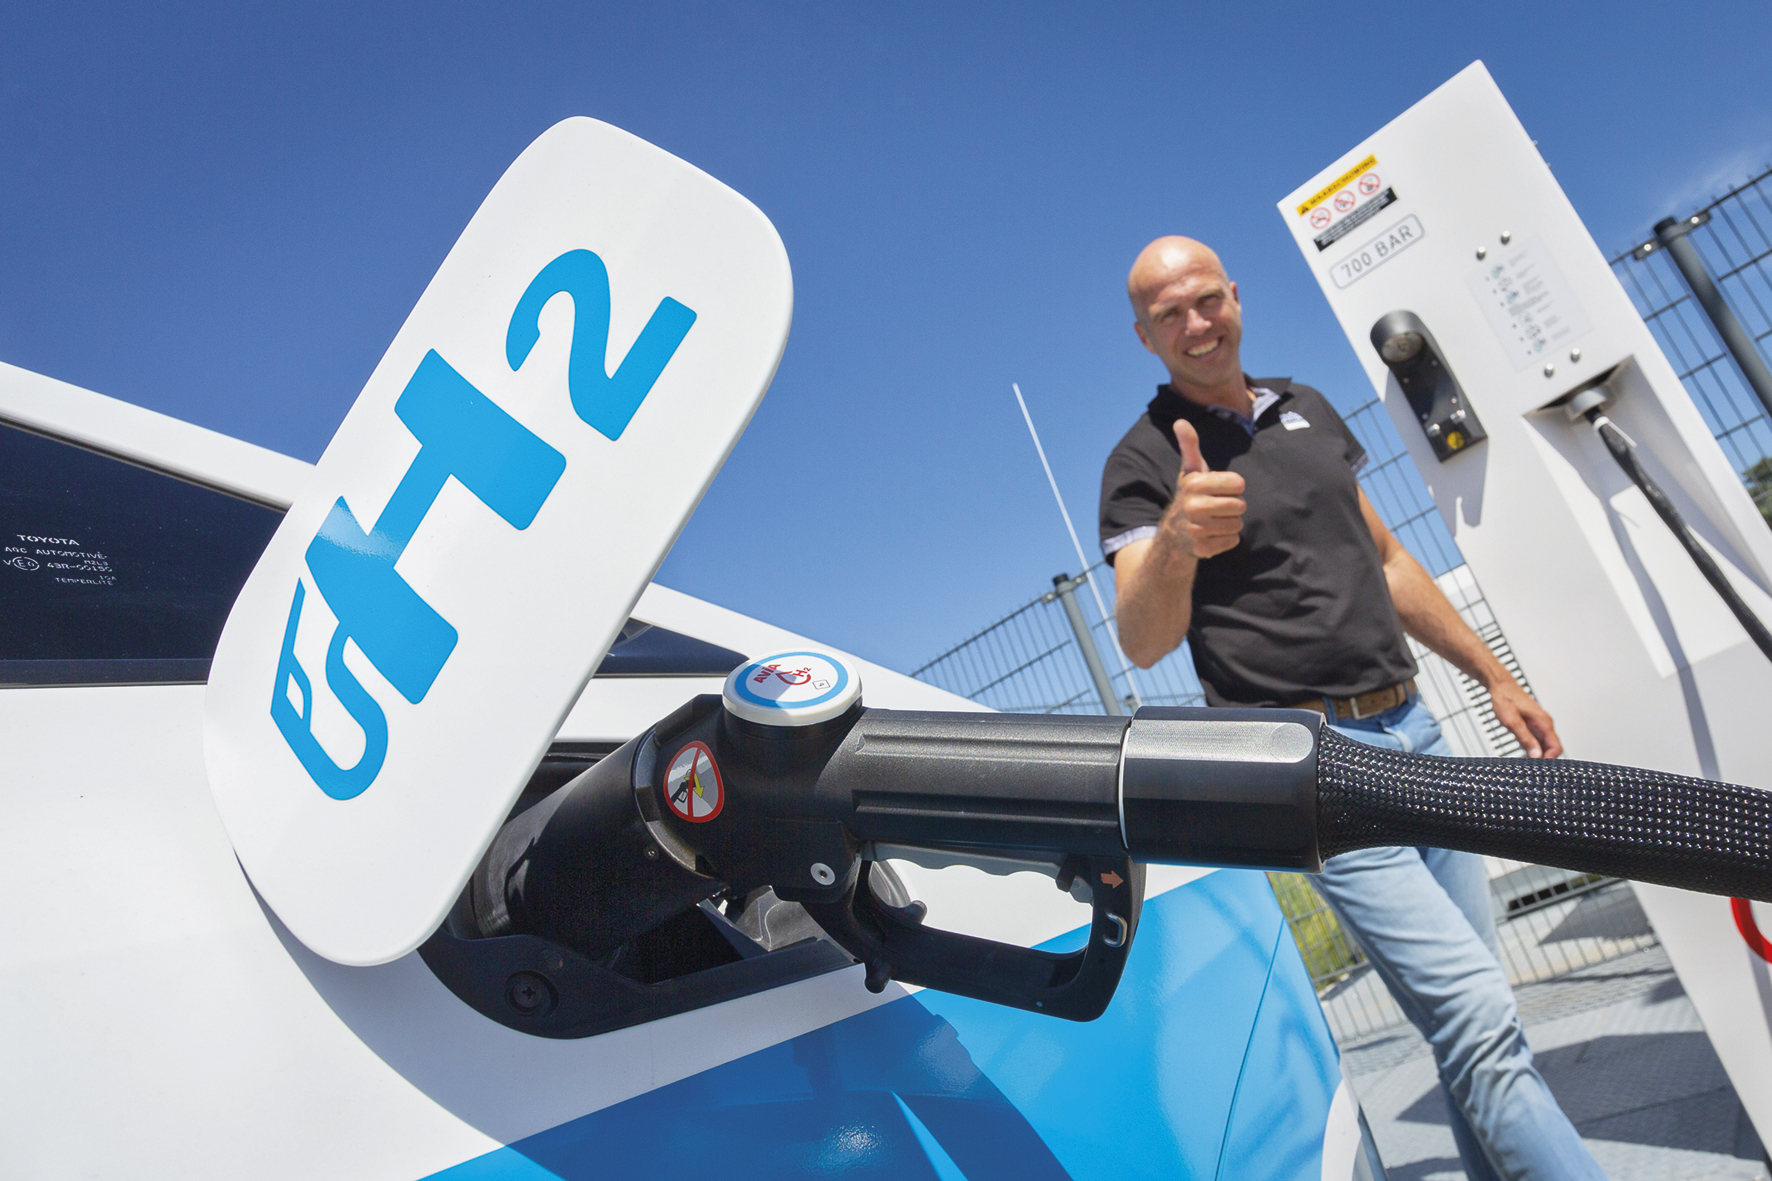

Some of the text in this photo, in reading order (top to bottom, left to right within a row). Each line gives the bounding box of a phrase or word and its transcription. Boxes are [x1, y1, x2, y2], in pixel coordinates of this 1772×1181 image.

[1340, 224, 1414, 279] 700 BAR
[16, 534, 80, 546] TOYOTA
